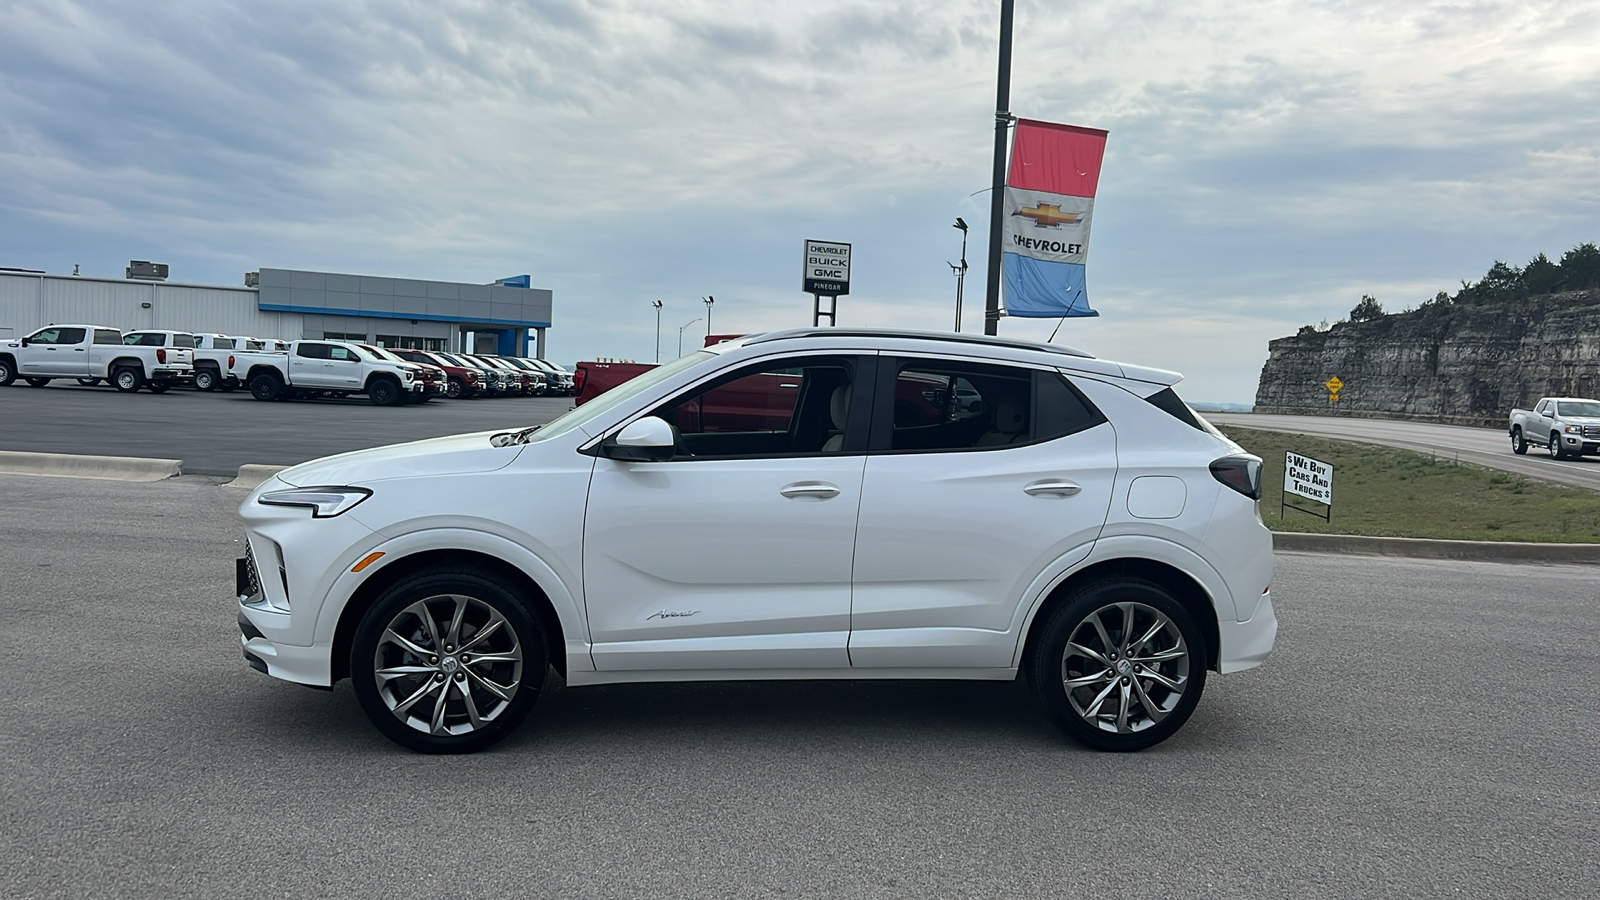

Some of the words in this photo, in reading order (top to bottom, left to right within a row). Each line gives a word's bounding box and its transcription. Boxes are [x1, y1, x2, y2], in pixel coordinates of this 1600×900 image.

[810, 245, 847, 255] CHEVROLET
[809, 257, 847, 267] BUICK
[814, 269, 842, 278] GMC
[813, 282, 841, 291] PINEGAR
